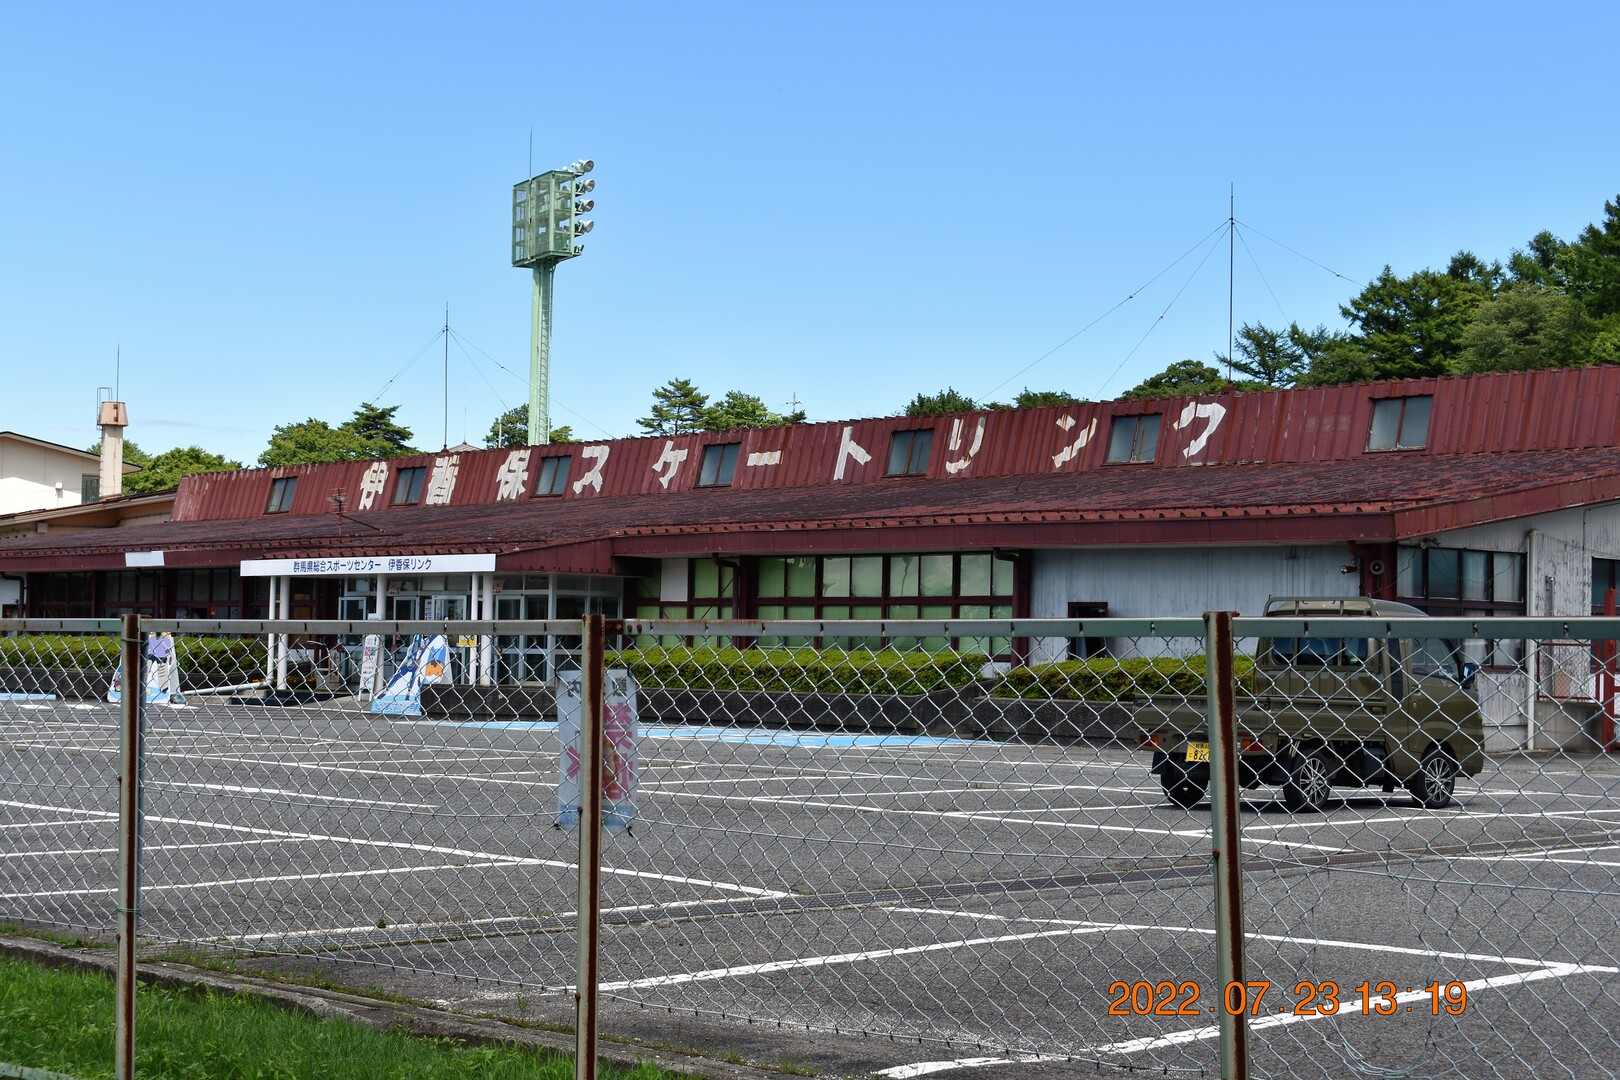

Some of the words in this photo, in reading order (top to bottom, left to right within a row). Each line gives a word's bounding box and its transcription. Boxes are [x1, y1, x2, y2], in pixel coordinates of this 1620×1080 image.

[359, 401, 1227, 510] 伊香保スケートリンク
[293, 560, 382, 573] 群馬県総合スポーツセンター
[388, 558, 432, 571] 伊香保リンク
